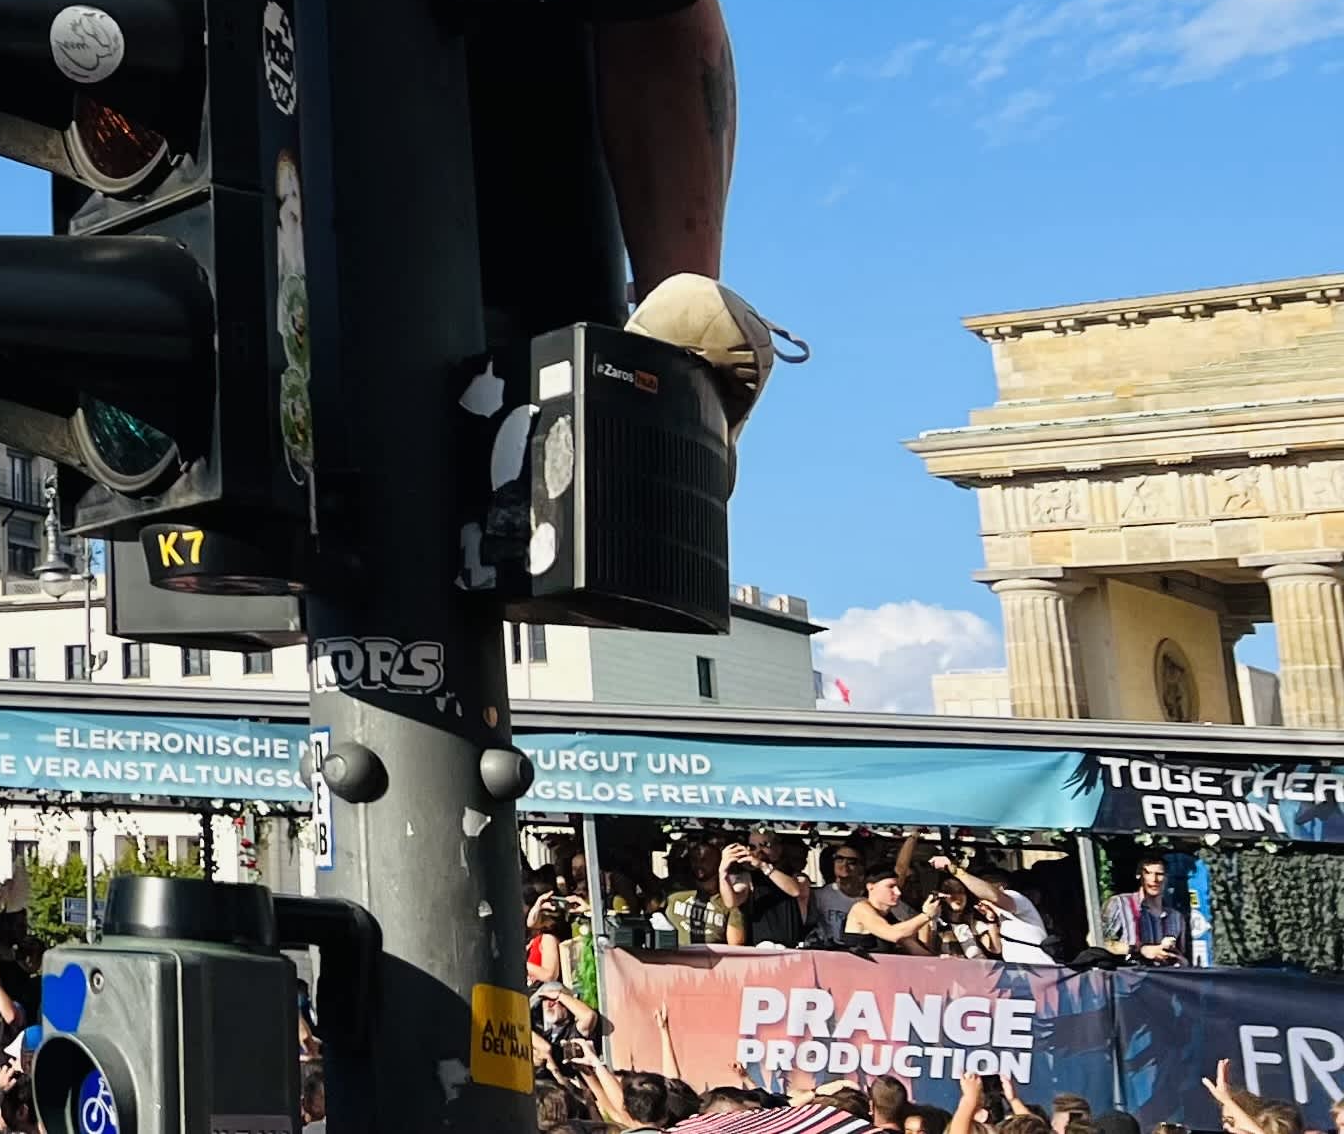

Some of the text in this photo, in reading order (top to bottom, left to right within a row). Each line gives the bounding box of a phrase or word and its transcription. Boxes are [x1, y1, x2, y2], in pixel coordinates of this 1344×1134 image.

[158, 530, 204, 567] K7
[55, 727, 290, 760] ELEKTRONISCHE
[647, 753, 712, 775] UND
[642, 784, 847, 808] FREITANZEN.
[1141, 794, 1288, 834] AGAIN
[739, 985, 1037, 1049] PRANGE
[482, 1035, 507, 1057] DEL
[736, 1038, 1033, 1084] PRODUCTION
